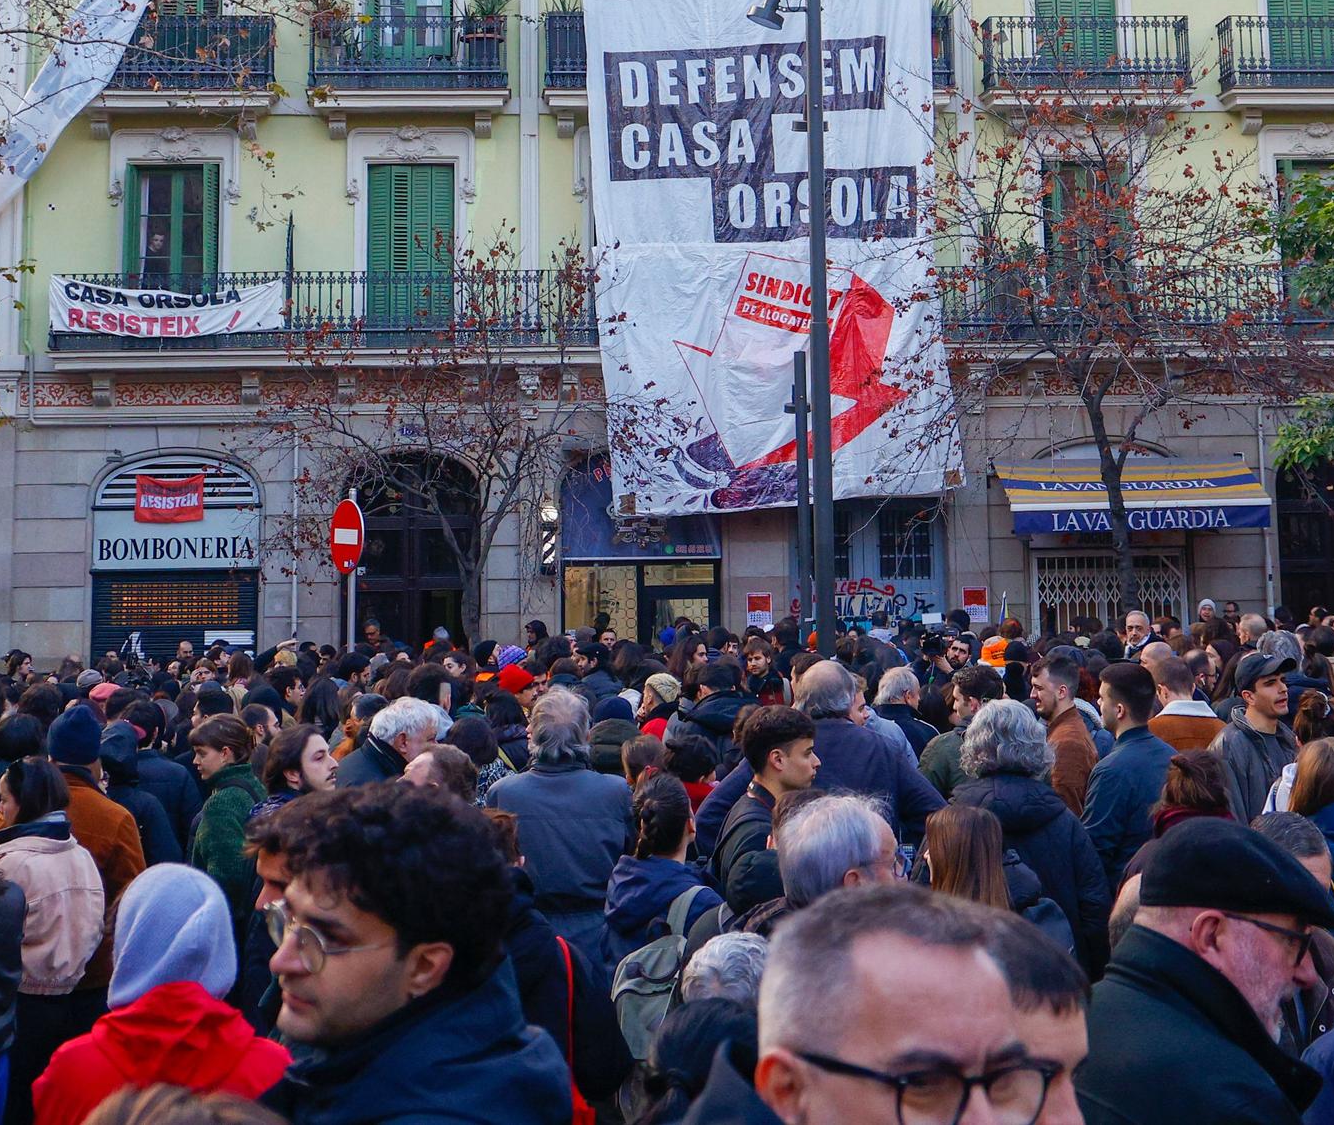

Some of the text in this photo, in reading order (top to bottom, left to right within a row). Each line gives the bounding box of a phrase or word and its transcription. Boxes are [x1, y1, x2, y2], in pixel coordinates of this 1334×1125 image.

[618, 46, 876, 108] DEFENSEM
[621, 118, 756, 170] CASA
[65, 283, 241, 309] CASA ORSOLA
[745, 272, 843, 311] SINDICT
[68, 308, 201, 338] RESISTEIX
[742, 302, 757, 316] DE
[140, 493, 199, 510] RESISTEIX
[98, 536, 253, 561] BOMBONERIA
